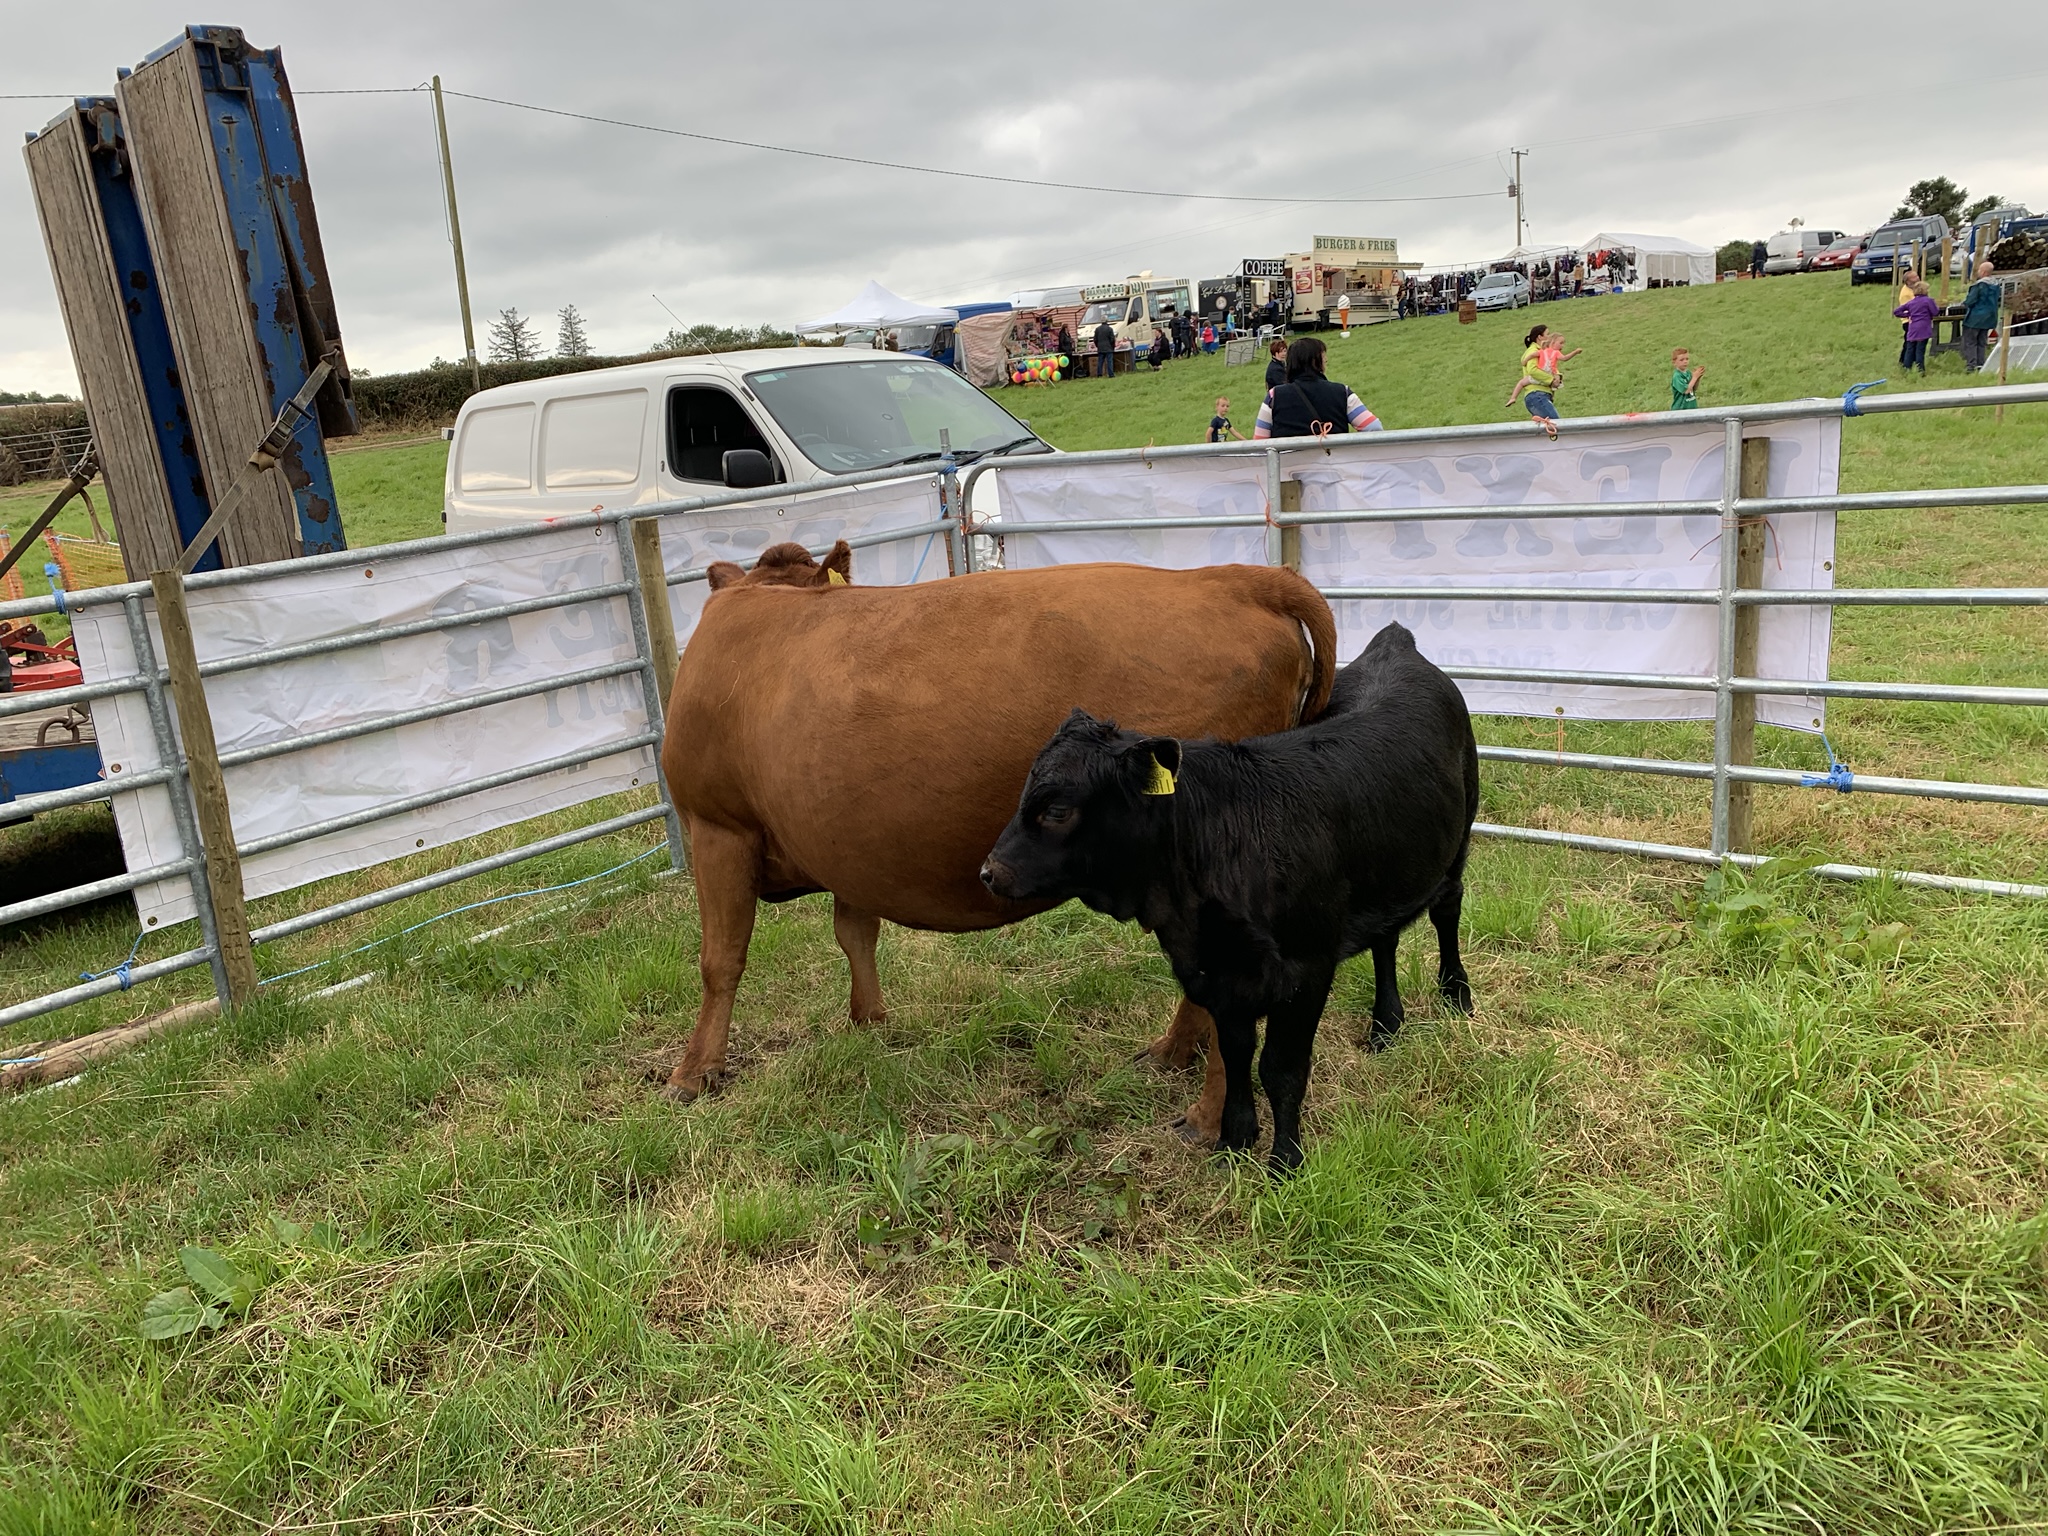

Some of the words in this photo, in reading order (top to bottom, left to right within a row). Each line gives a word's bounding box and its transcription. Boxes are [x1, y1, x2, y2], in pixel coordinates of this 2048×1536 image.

[1315, 238, 1357, 250] BURGER
[1358, 240, 1365, 250] &
[1367, 240, 1396, 251] FRIES
[1245, 260, 1284, 275] COFFEE
[1112, 285, 1125, 294] ICES
